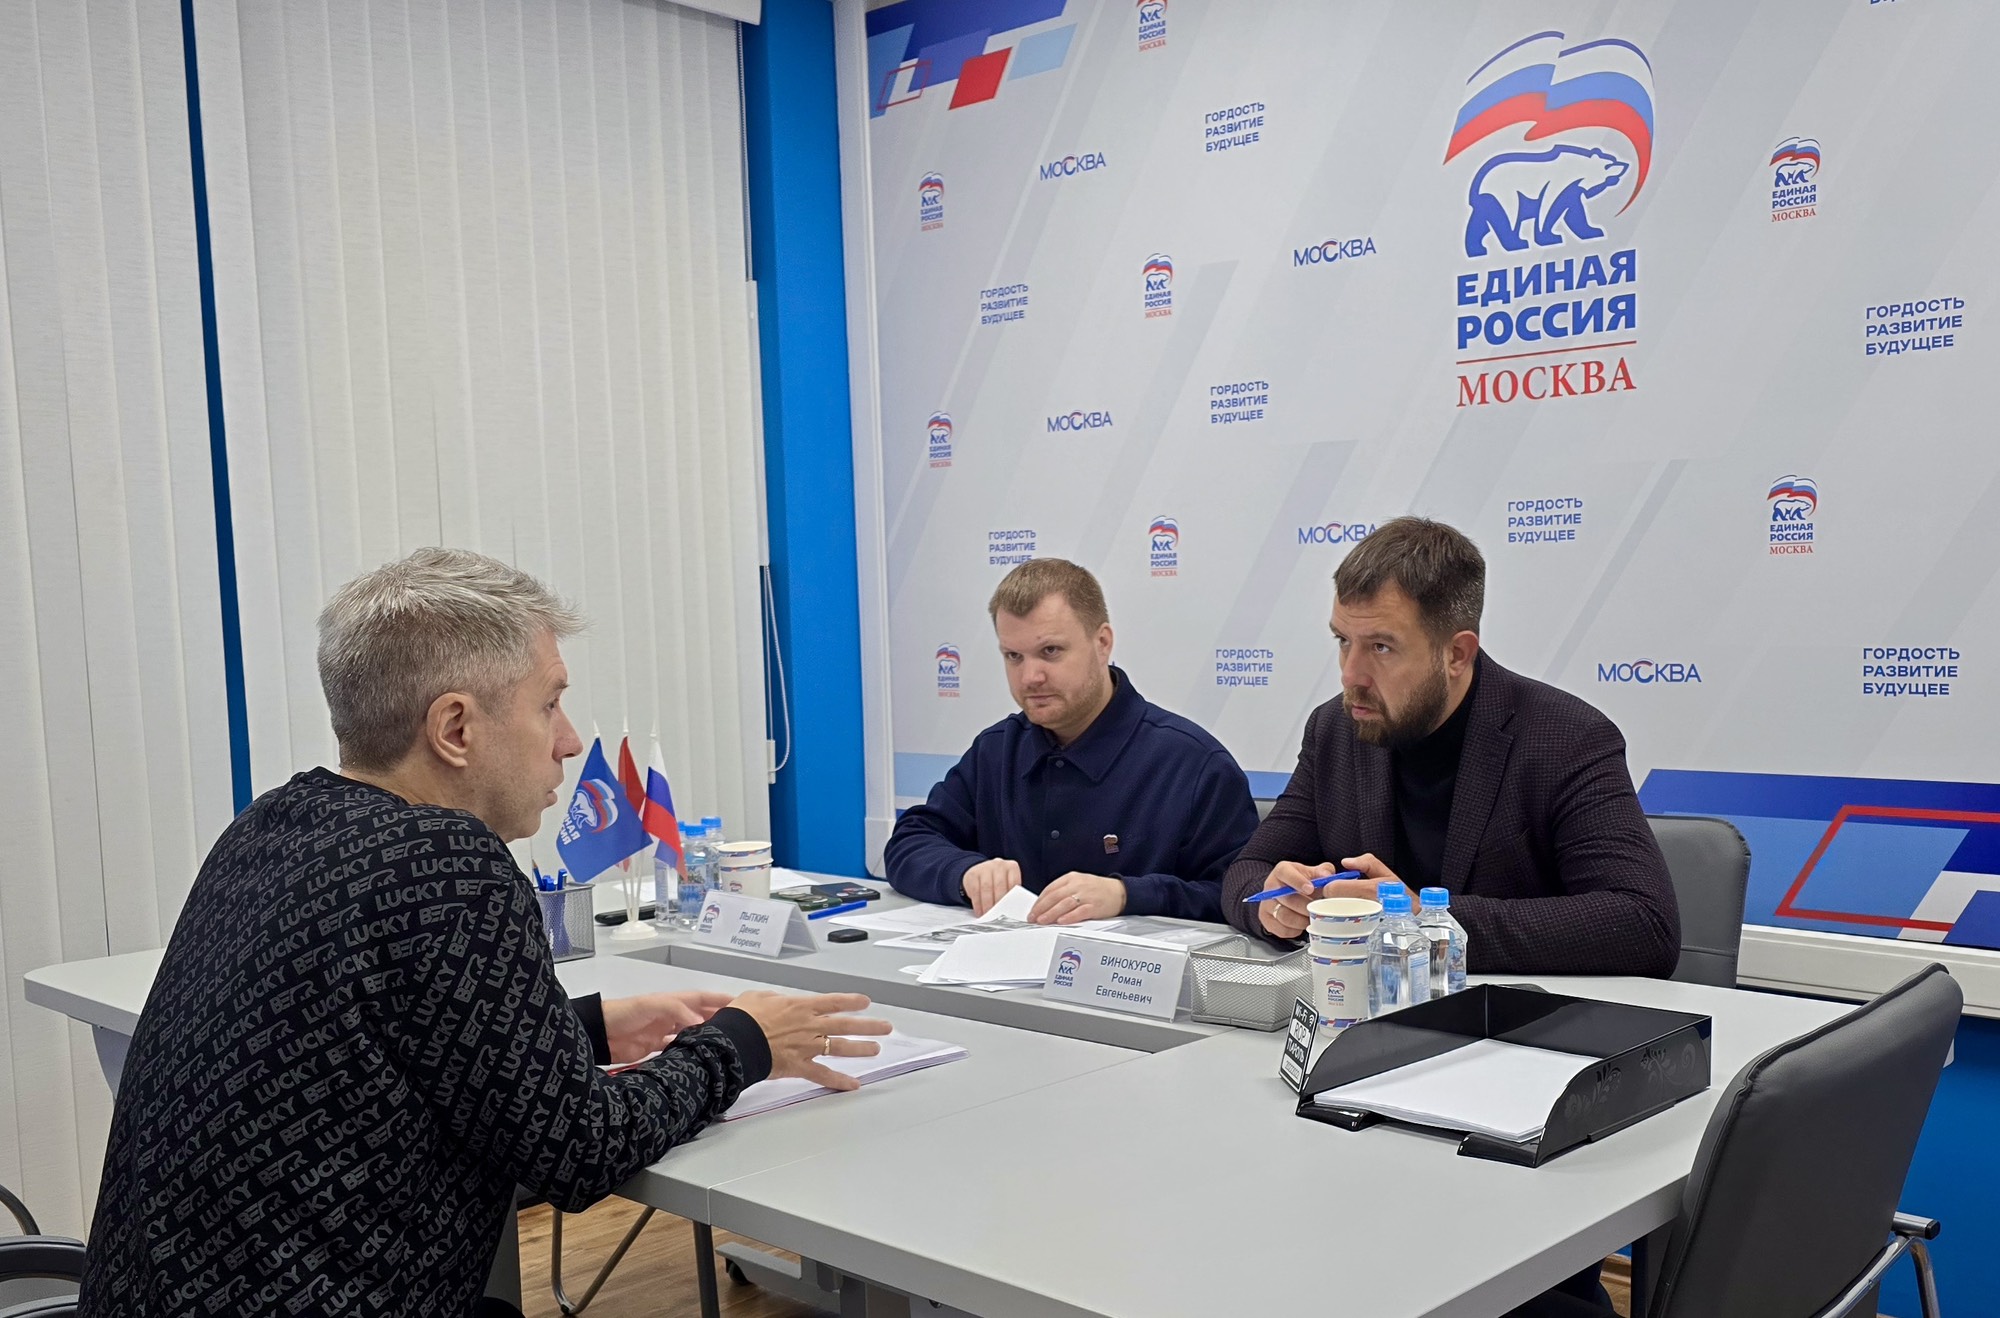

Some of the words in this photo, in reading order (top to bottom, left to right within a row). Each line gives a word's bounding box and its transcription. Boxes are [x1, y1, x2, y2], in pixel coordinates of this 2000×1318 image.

[1139, 20, 1166, 34] ЕДИНАЯ
[1139, 28, 1166, 41] РОССИЯ
[1139, 40, 1166, 52] МОСКВА
[1205, 102, 1265, 123] ГОРДОСТЬ
[1205, 116, 1264, 138] РАЗВИТИЕ
[1206, 132, 1260, 152] БУДУЩЕЕ
[1040, 152, 1106, 181] МОСКВА
[1772, 185, 1816, 199] ЕДИНАЯ
[1772, 194, 1816, 209] РОССИЯ
[1772, 207, 1817, 222] МОСКВА
[1294, 237, 1376, 267] МОСКВА
[1457, 249, 1636, 307] ЕДИНАЯ
[980, 284, 1029, 300] ГОРДОСТЬ
[1145, 290, 1171, 301] ЕДИНАЯ
[981, 297, 1028, 312] РАЗВИТИЕ
[1145, 298, 1171, 309] РОССИЯ
[1866, 297, 1965, 320] ГОРДОСТЬ
[981, 311, 1024, 325] БУДУЩЕЕ
[1457, 294, 1636, 350] РОССИЯ
[1866, 315, 1963, 337] РАЗВИТИЕ
[1866, 335, 1954, 356] БУДУЩЕЕ
[1210, 381, 1269, 396] ГОРДОСТЬ
[1456, 357, 1637, 407] МОСКВА
[1211, 395, 1268, 410] РАЗВИТИЕ
[1047, 411, 1113, 432] МОСКВА
[1211, 410, 1264, 424] БУДУЩЕЕ
[1508, 498, 1583, 513] ГОРДОСТЬ
[1508, 514, 1582, 527] РАЗВИТИЕ
[1770, 523, 1813, 533] ЕДИНАЯ
[988, 530, 1036, 542] ГОРДОСТЬ
[1508, 530, 1575, 544] БУДУЩЕЕ
[1770, 532, 1813, 542] РОССИЯ
[989, 543, 1036, 553] РАЗВИТИЕ
[1770, 545, 1813, 555] МОСКВА
[1151, 560, 1177, 568] РОССИЯ
[1216, 650, 1274, 660] ГОРДОСТЬ
[1863, 648, 1960, 662] ГОРДОСТЬ
[1216, 663, 1273, 672] РАЗВИТИЕ
[1598, 658, 1702, 683] МОСКВА
[1863, 666, 1958, 678] РАЗВИТИЕ
[1217, 676, 1269, 687] БУДУЩЕЕ
[1863, 683, 1950, 696] БУДУЩЕЕ
[282, 815, 339, 857] LUCKY
[257, 847, 307, 892] LUCKY
[372, 808, 443, 828] LUCKY
[237, 883, 279, 932] LUCKY
[338, 822, 408, 859] LUCKY
[215, 920, 256, 972] LUCKY
[307, 854, 372, 895] LUCKY
[740, 912, 769, 924] ЛЫТКИН
[193, 960, 233, 1011] LUCKY
[278, 889, 339, 933] LUCKY
[411, 856, 483, 877] LUCKY
[255, 926, 310, 973] LUCKY
[374, 880, 447, 912] LUCKY
[738, 924, 760, 935] Денис
[730, 935, 762, 949] Игоревич
[486, 917, 521, 989] LUCKY
[1100, 956, 1162, 974] ВИНОКУРОВ
[1111, 973, 1142, 987] Роман
[153, 1041, 189, 1093] LUCKY
[233, 965, 286, 1013] LUCKY
[344, 912, 411, 948] LUCKY
[212, 1005, 264, 1055] LUCKY
[324, 946, 380, 986] LUCKY
[412, 960, 456, 1026] LUCKY
[491, 963, 530, 1035] LUCKY
[1096, 986, 1152, 1004] Евгеньевич
[1295, 1004, 1308, 1023] Wi-Fi
[193, 1046, 240, 1097] LUCKY
[302, 981, 354, 1024] LUCKY
[420, 1005, 461, 1067] LUCKY
[498, 1009, 536, 1080] LUCKY
[1287, 1038, 1305, 1063] ПАРОЛЬ
[175, 1088, 219, 1139] LUCKY
[277, 1019, 340, 1064] LUCKY
[254, 1056, 319, 1104] LUCKY
[434, 1047, 468, 1107] LUCKY
[505, 1055, 544, 1124] LUCKY
[212, 1137, 273, 1189] LUCKY
[338, 1060, 397, 1111] LUCKY
[231, 1096, 296, 1147] LUCKY
[513, 1101, 550, 1162] LUCKY
[200, 1179, 252, 1231] LUCKY
[315, 1102, 381, 1152] LUCKY
[181, 1221, 236, 1273] LUCKY
[291, 1142, 359, 1195] LUCKY
[272, 1184, 336, 1234] LUCKY
[418, 1189, 458, 1242] LUCKY
[256, 1224, 317, 1277] LUCKY
[337, 1218, 393, 1273] LUCKY
[322, 1263, 381, 1318] LUCKY
